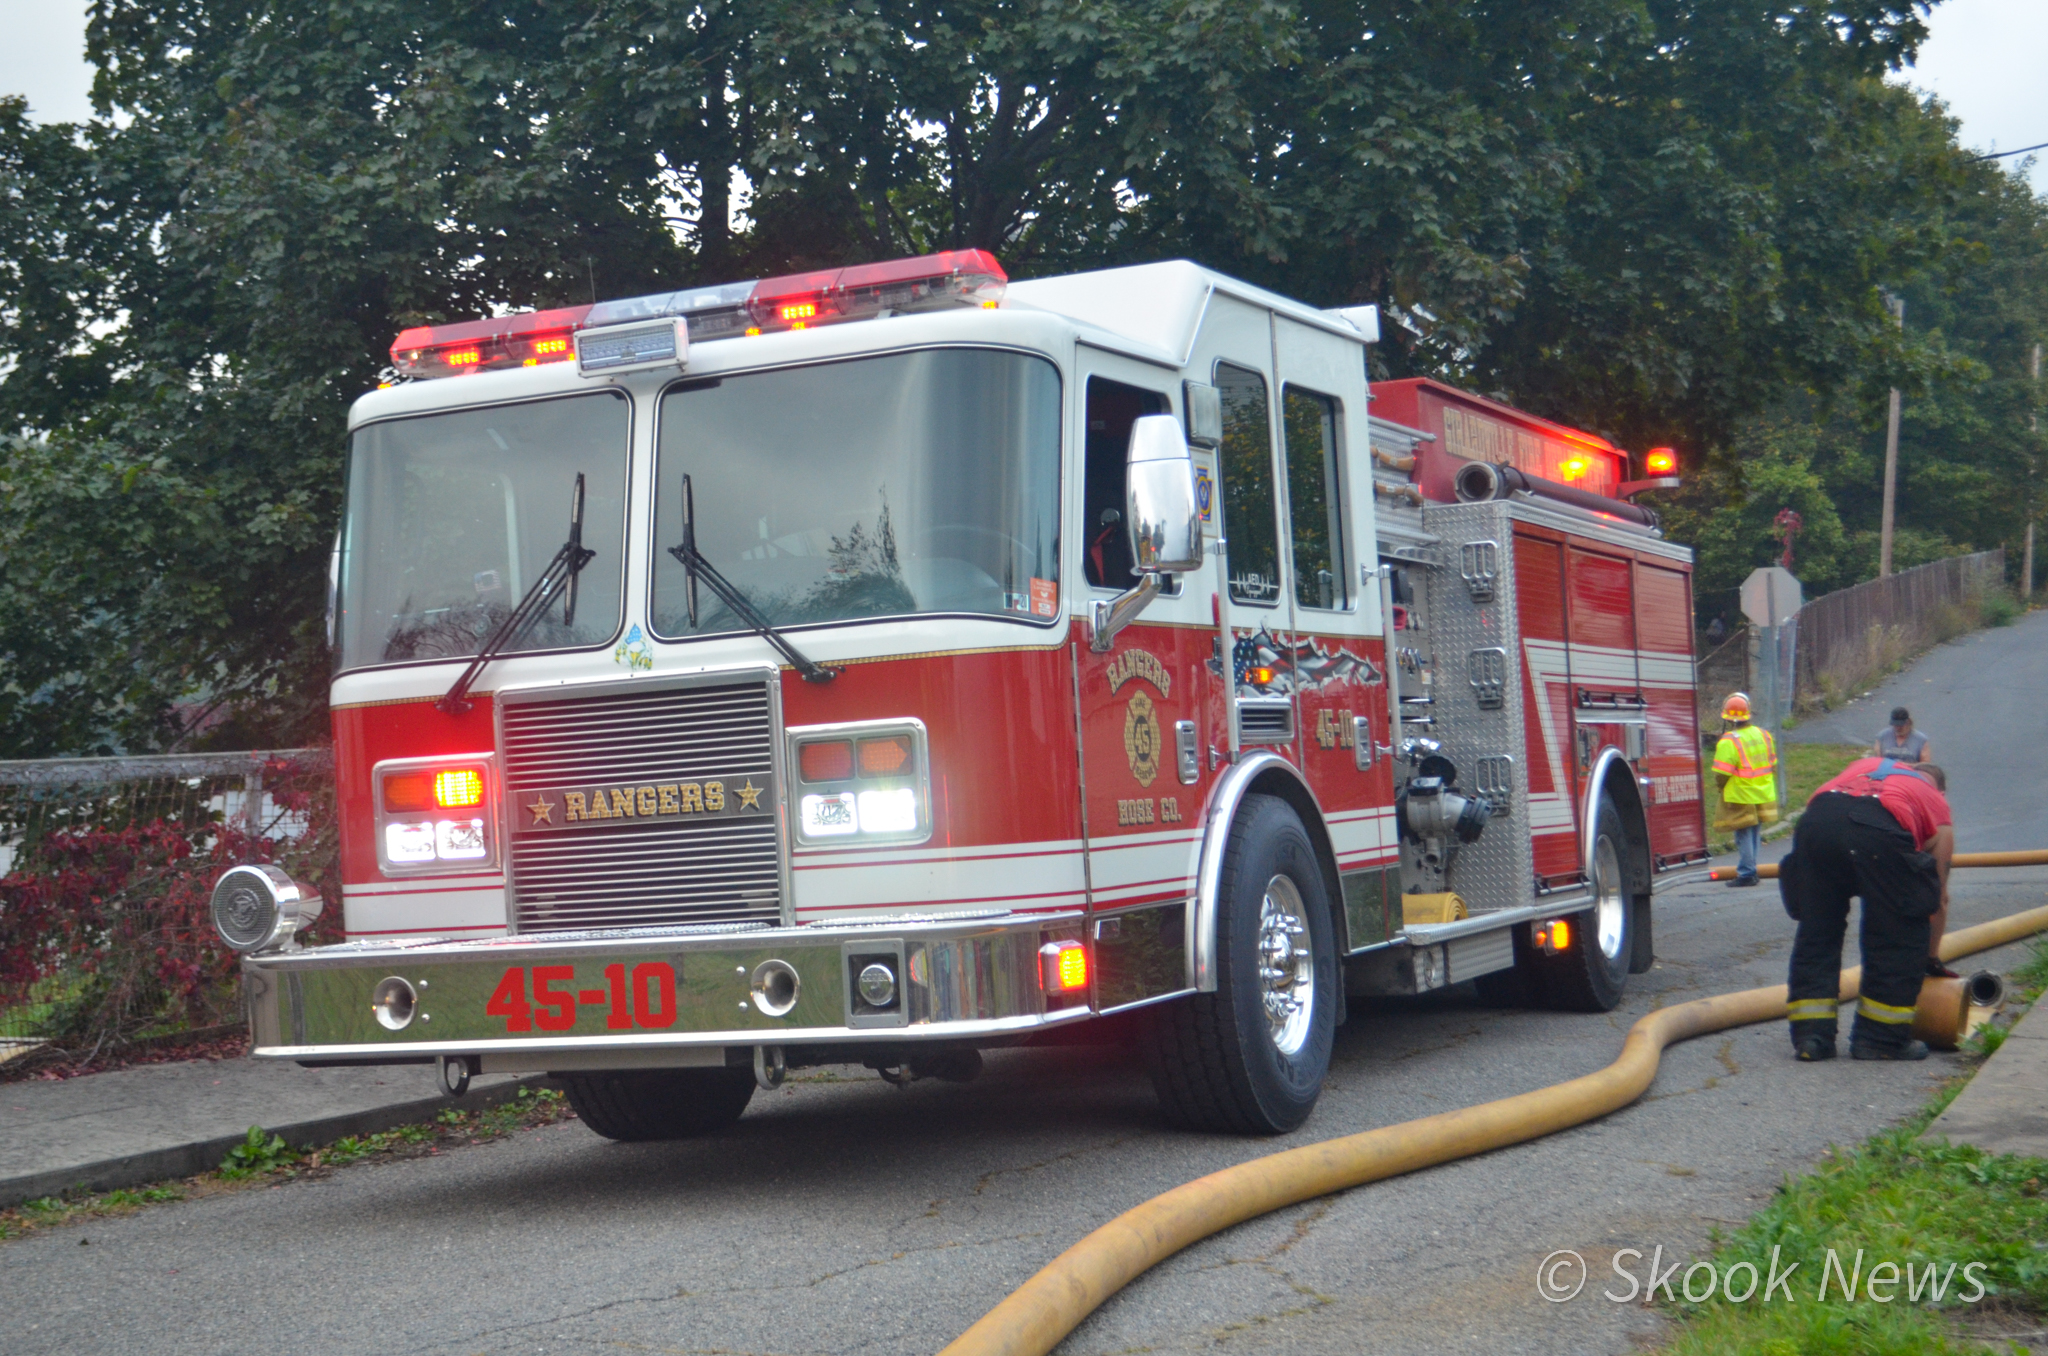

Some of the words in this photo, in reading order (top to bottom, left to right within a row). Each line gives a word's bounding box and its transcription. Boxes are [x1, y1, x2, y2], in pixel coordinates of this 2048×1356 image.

[1106, 649, 1171, 698] RANGERS
[1135, 723, 1150, 754] 45
[1316, 709, 1354, 750] 45-10
[564, 781, 725, 822] RANGERS
[1118, 798, 1155, 826] HOSE
[1161, 797, 1182, 822] CO.
[486, 962, 677, 1032] 45-10
